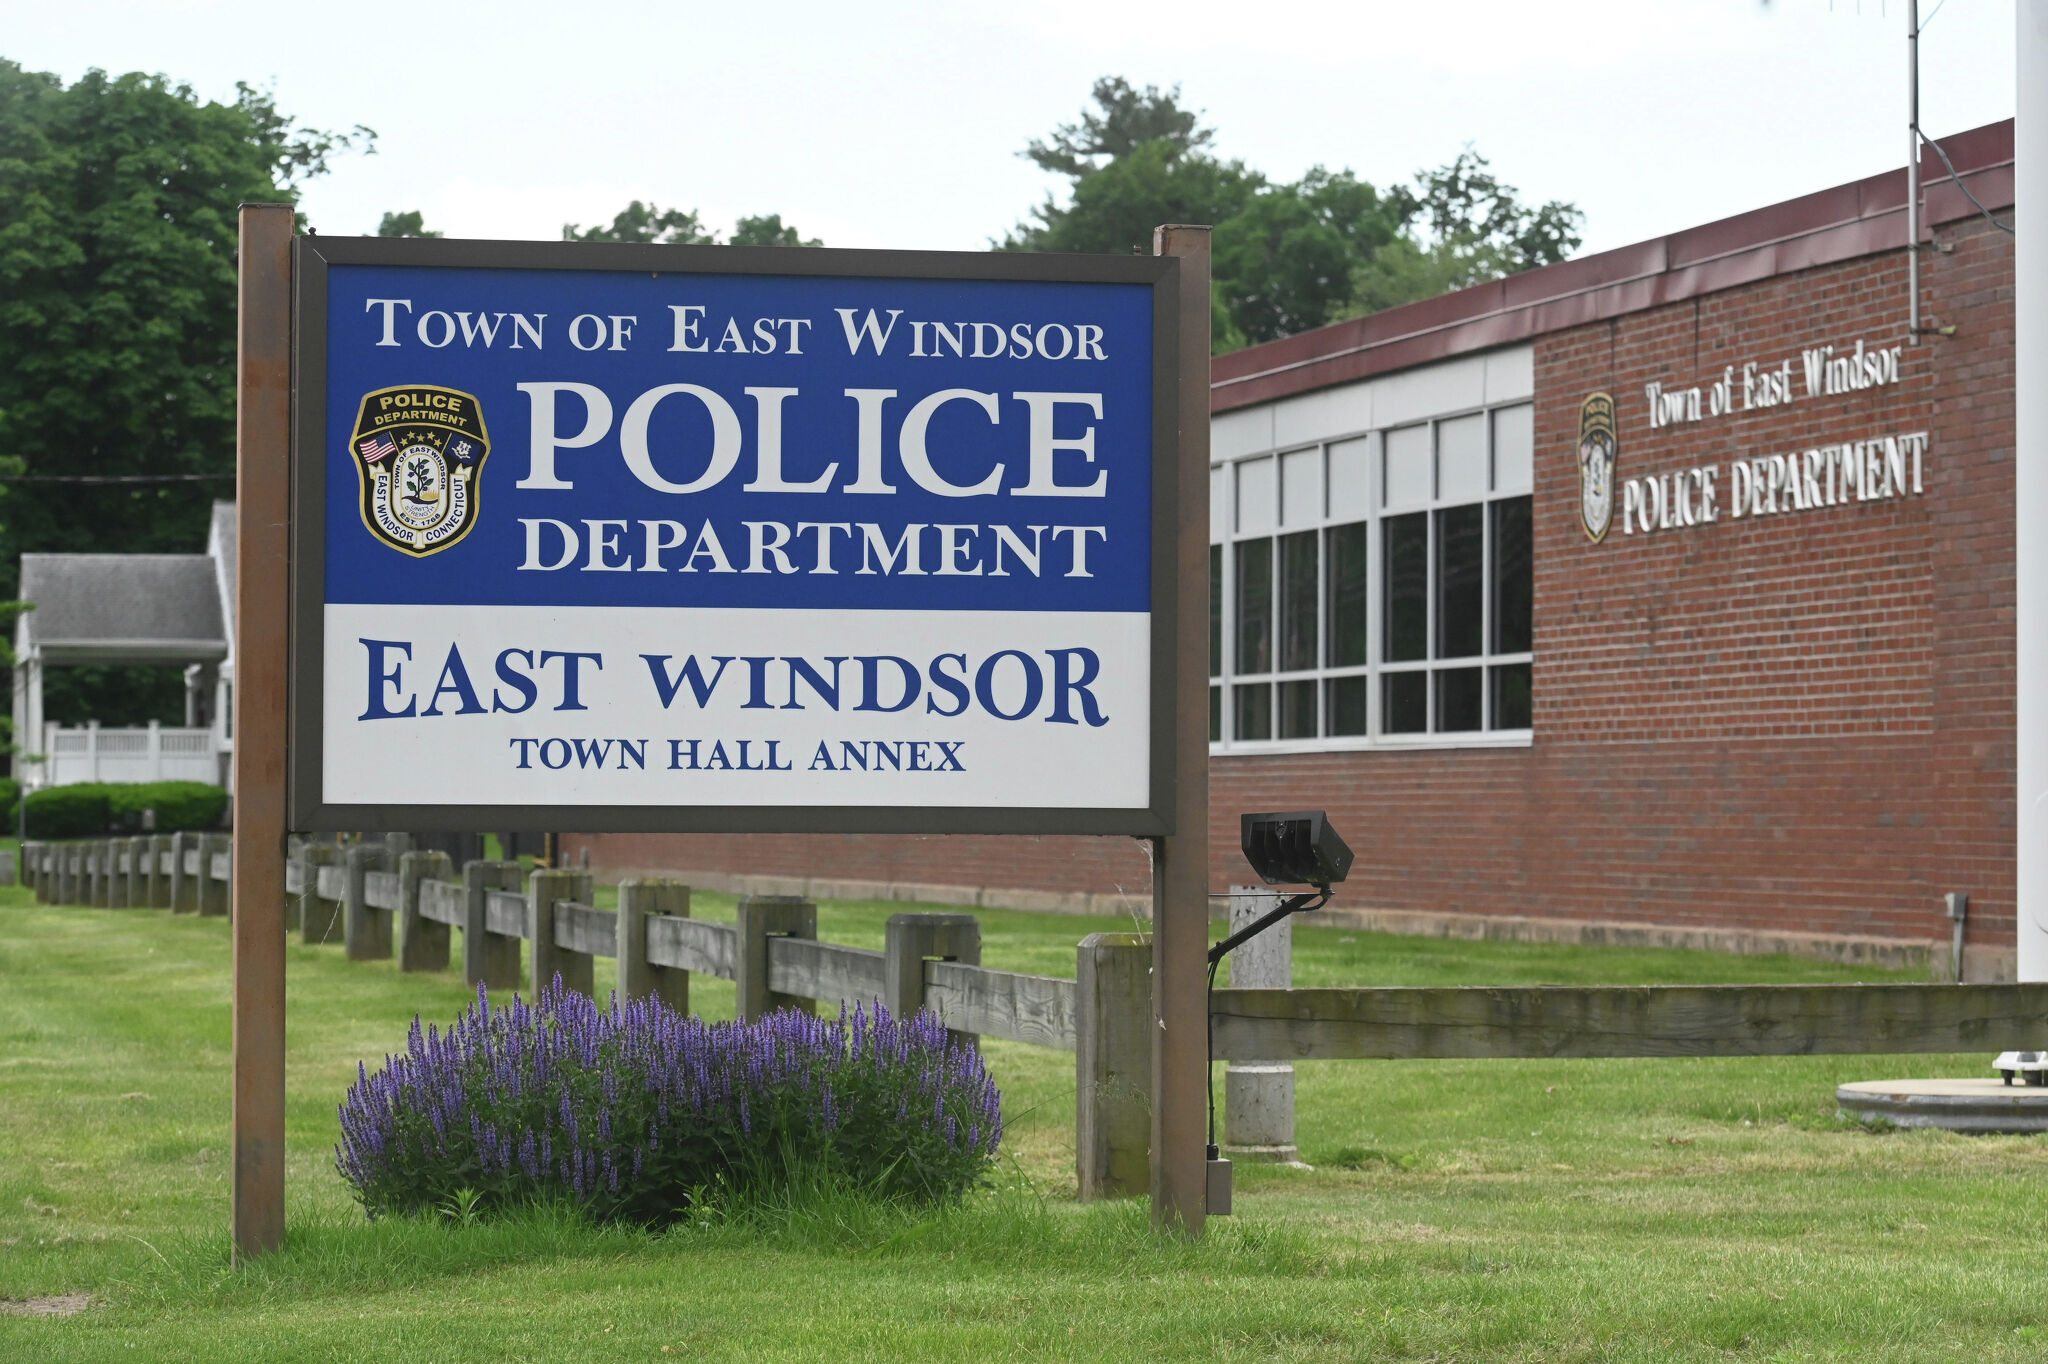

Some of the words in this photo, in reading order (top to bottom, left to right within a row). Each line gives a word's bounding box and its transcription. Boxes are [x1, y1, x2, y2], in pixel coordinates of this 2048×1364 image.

[366, 298, 547, 351] TOWN
[569, 313, 637, 353] OF
[667, 304, 812, 356] EAST
[834, 308, 1109, 362] WINDSOR
[379, 393, 463, 412] POLICE
[1645, 381, 1703, 428] Town
[1710, 365, 1734, 417] of
[1743, 359, 1792, 410] East
[1801, 339, 1902, 397] Windsor
[374, 410, 468, 427] DEPARTMENT
[515, 381, 1109, 499] POLICE
[376, 475, 388, 501] EAST
[399, 452, 407, 463] OF
[431, 452, 446, 490] WINDSOR
[1623, 465, 1719, 535] POLICE
[1731, 431, 1929, 518] DEPARTMENT
[376, 504, 414, 541] WINDSOR
[400, 512, 418, 526] EST.
[421, 513, 441, 526] 1768
[425, 478, 464, 541] CONNECTICUT
[517, 517, 1108, 579] DEPARTMENT
[358, 637, 603, 723] EAST
[639, 646, 1110, 728] WINDSOR
[510, 737, 649, 771] TOWN
[667, 738, 793, 771] HALL
[808, 739, 967, 772] ANNEX
